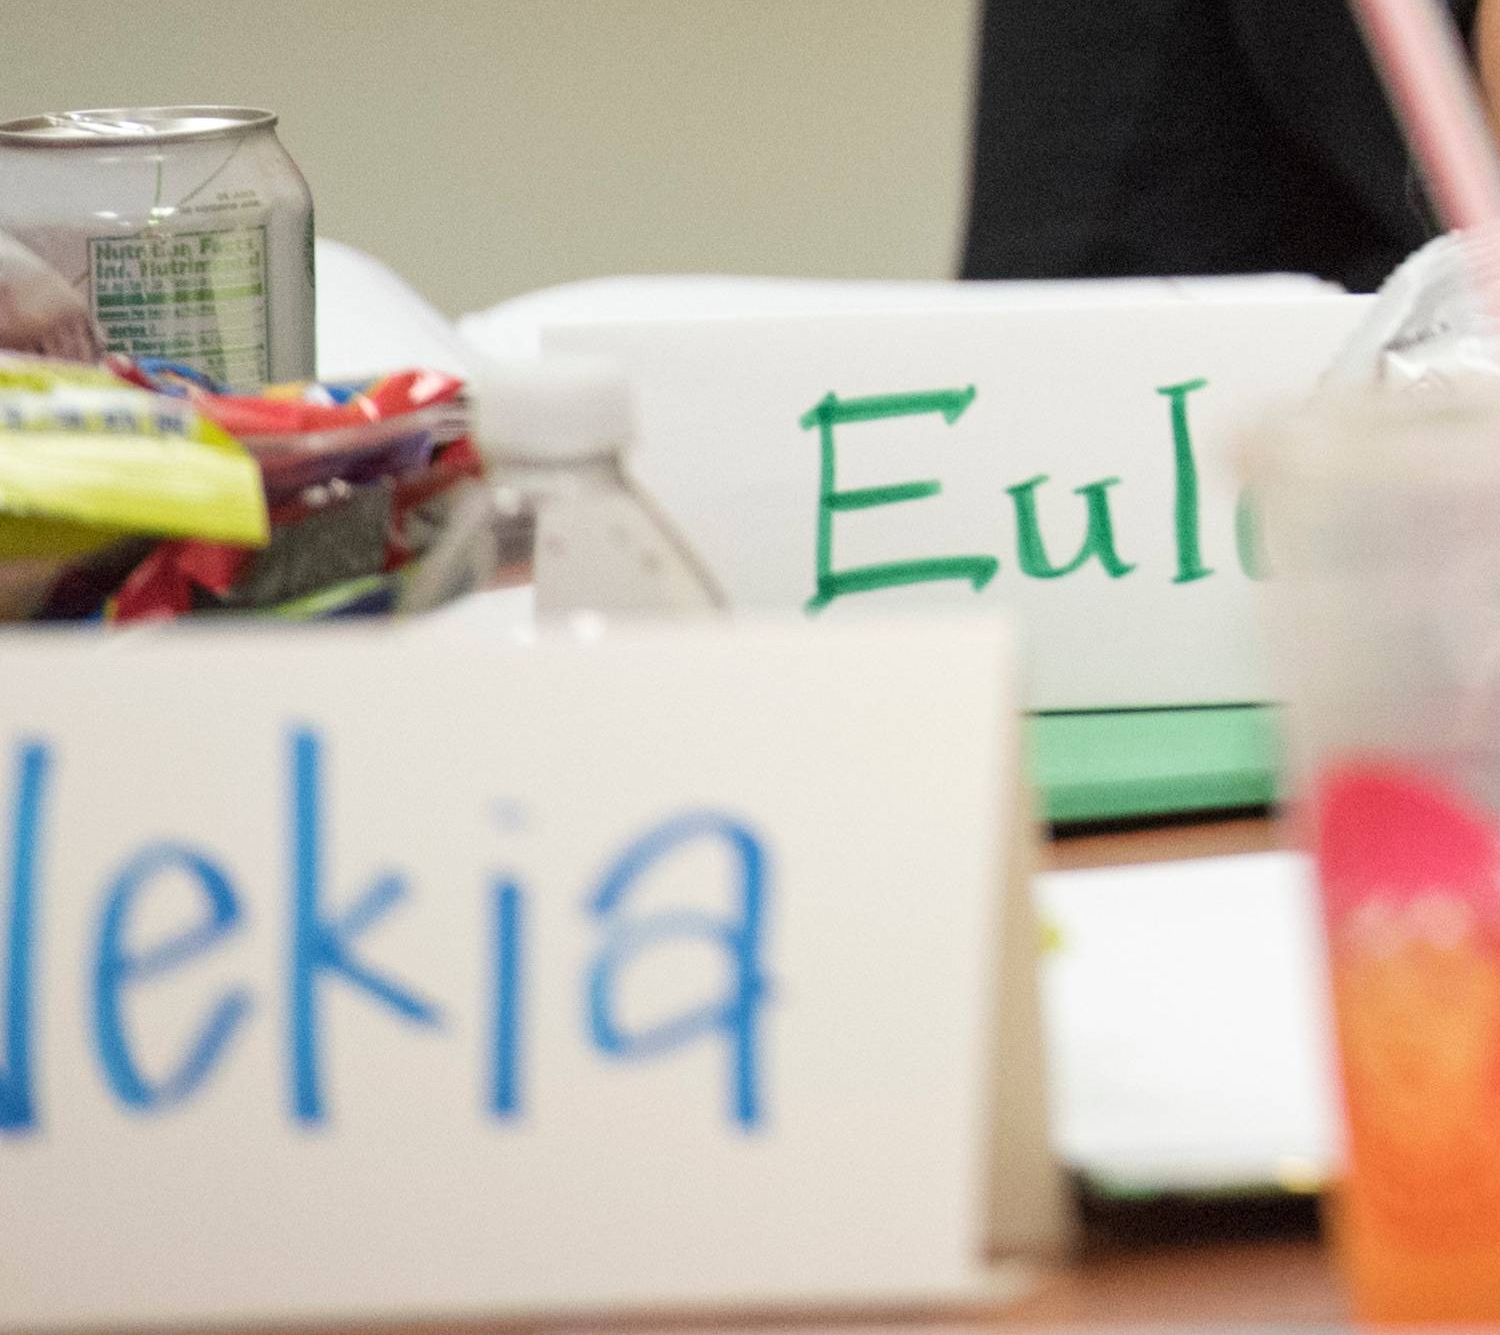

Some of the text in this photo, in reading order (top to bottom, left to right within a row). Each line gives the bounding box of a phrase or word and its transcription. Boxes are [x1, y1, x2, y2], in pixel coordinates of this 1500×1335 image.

[95, 236, 255, 261] Nutrtion Fas
[139, 250, 261, 279] Nutrimal
